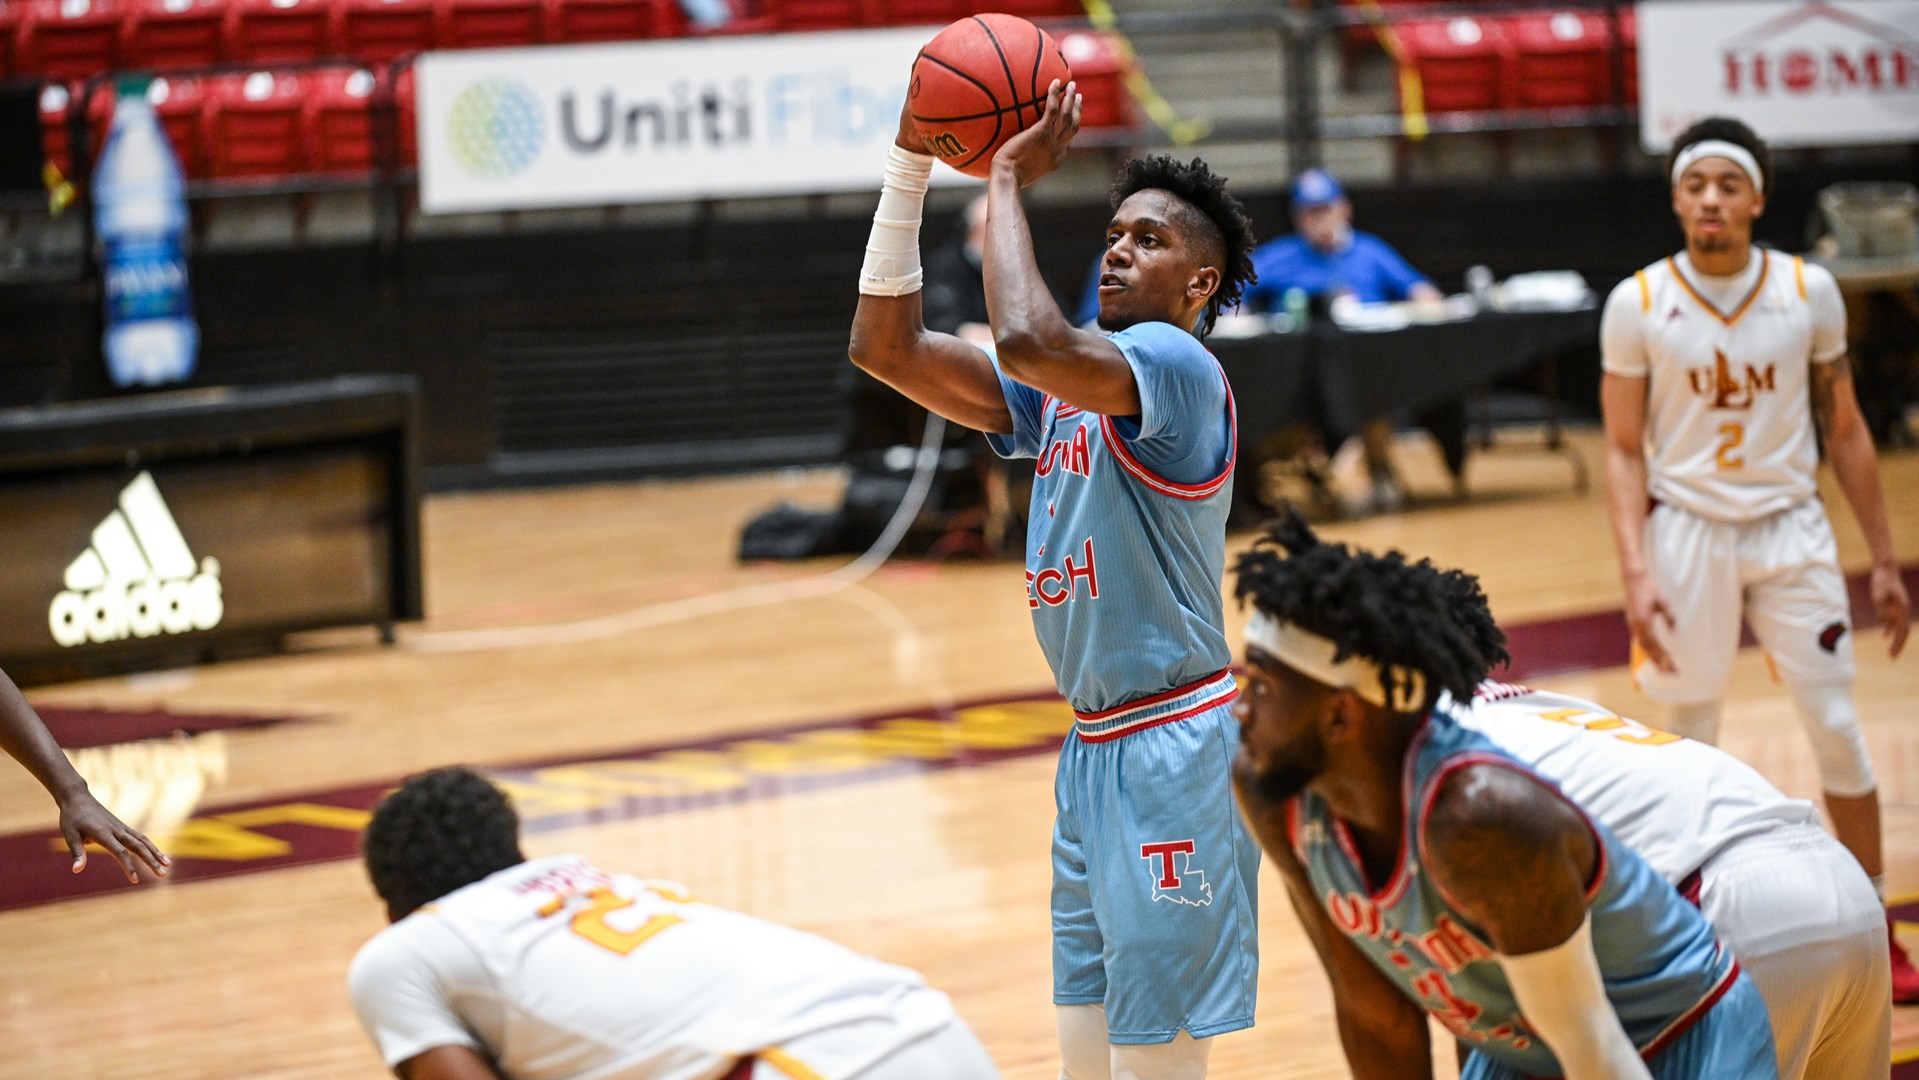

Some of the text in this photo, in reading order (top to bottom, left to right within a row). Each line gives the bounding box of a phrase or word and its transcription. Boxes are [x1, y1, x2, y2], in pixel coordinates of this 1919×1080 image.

[557, 73, 752, 153] Uniti
[1716, 421, 1744, 470] 2
[48, 570, 224, 648] adidas
